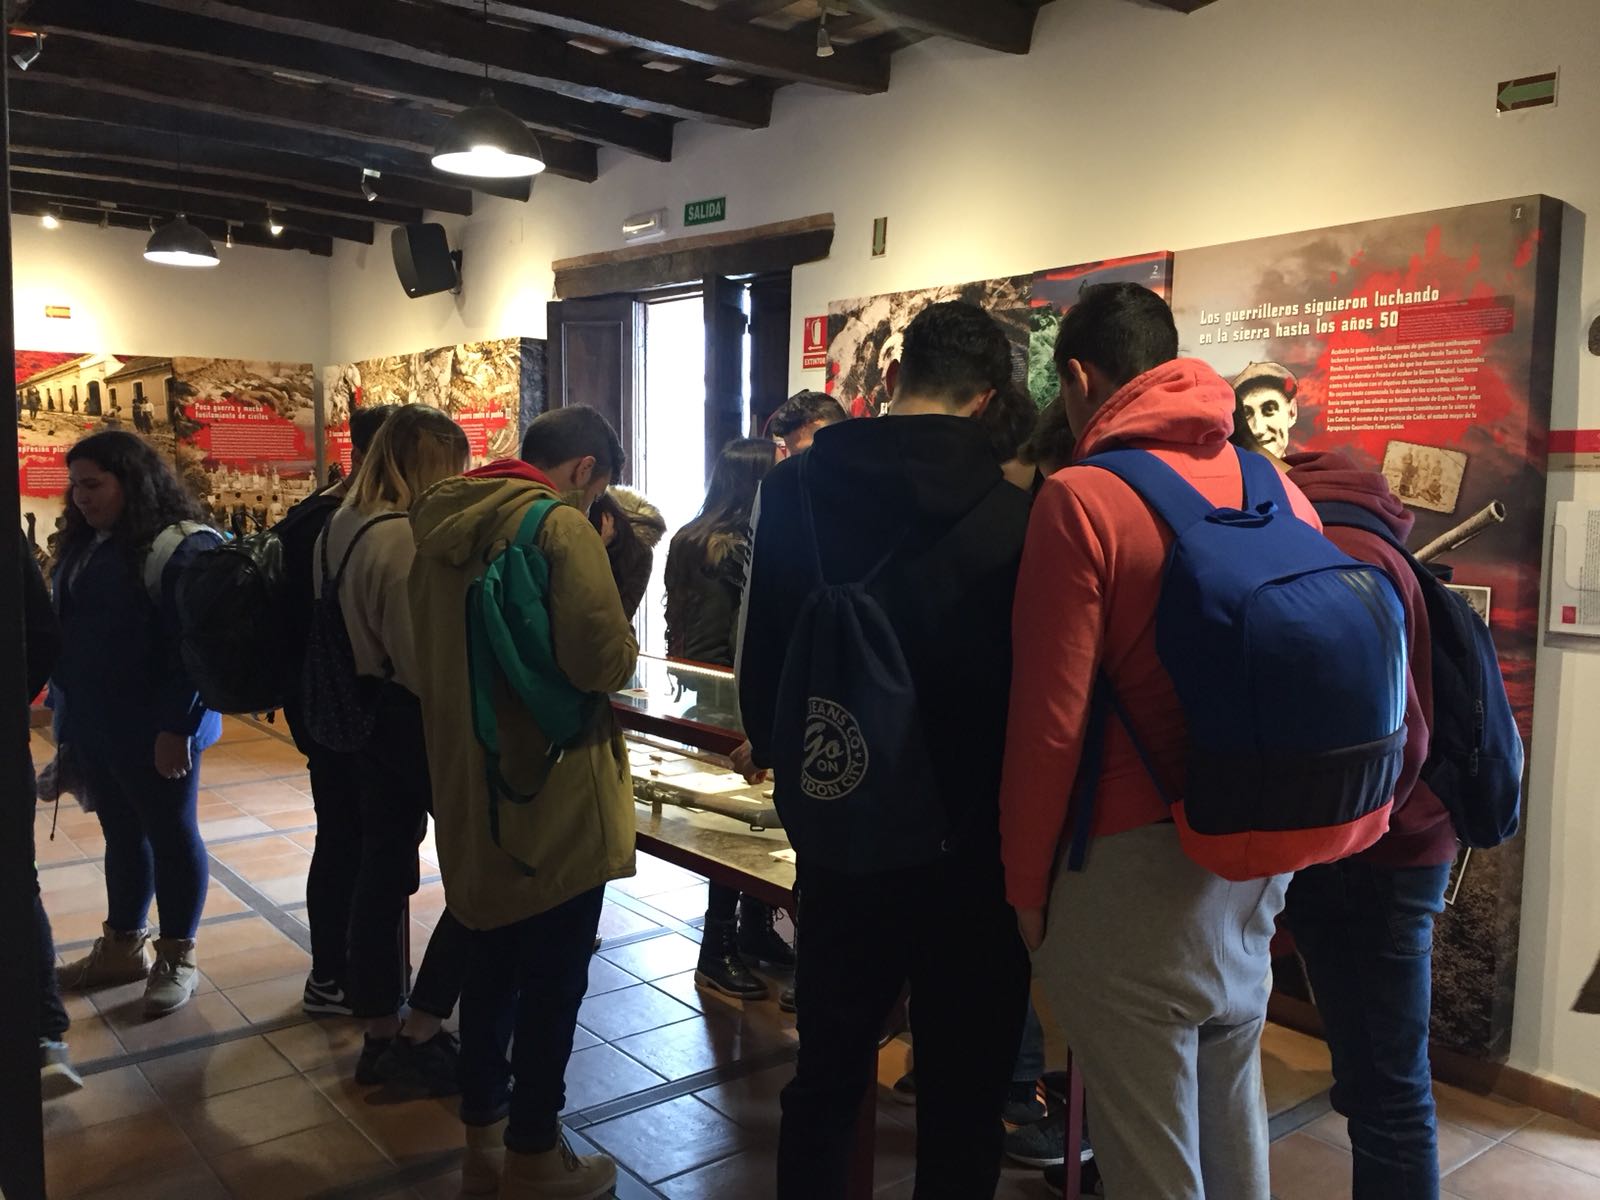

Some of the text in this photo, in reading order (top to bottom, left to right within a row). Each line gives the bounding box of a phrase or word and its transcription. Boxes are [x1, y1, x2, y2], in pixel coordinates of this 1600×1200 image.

[688, 201, 722, 220] SALIDA
[1153, 265, 1158, 275] 2
[1200, 285, 1439, 326] Los guerrilleros siguieron luchando
[1200, 311, 1399, 344] en la sierra hasta los años 50
[195, 402, 210, 411] Poca
[808, 702, 848, 726] JEANS
[817, 760, 839, 773] ON
[842, 760, 863, 787] CITY
